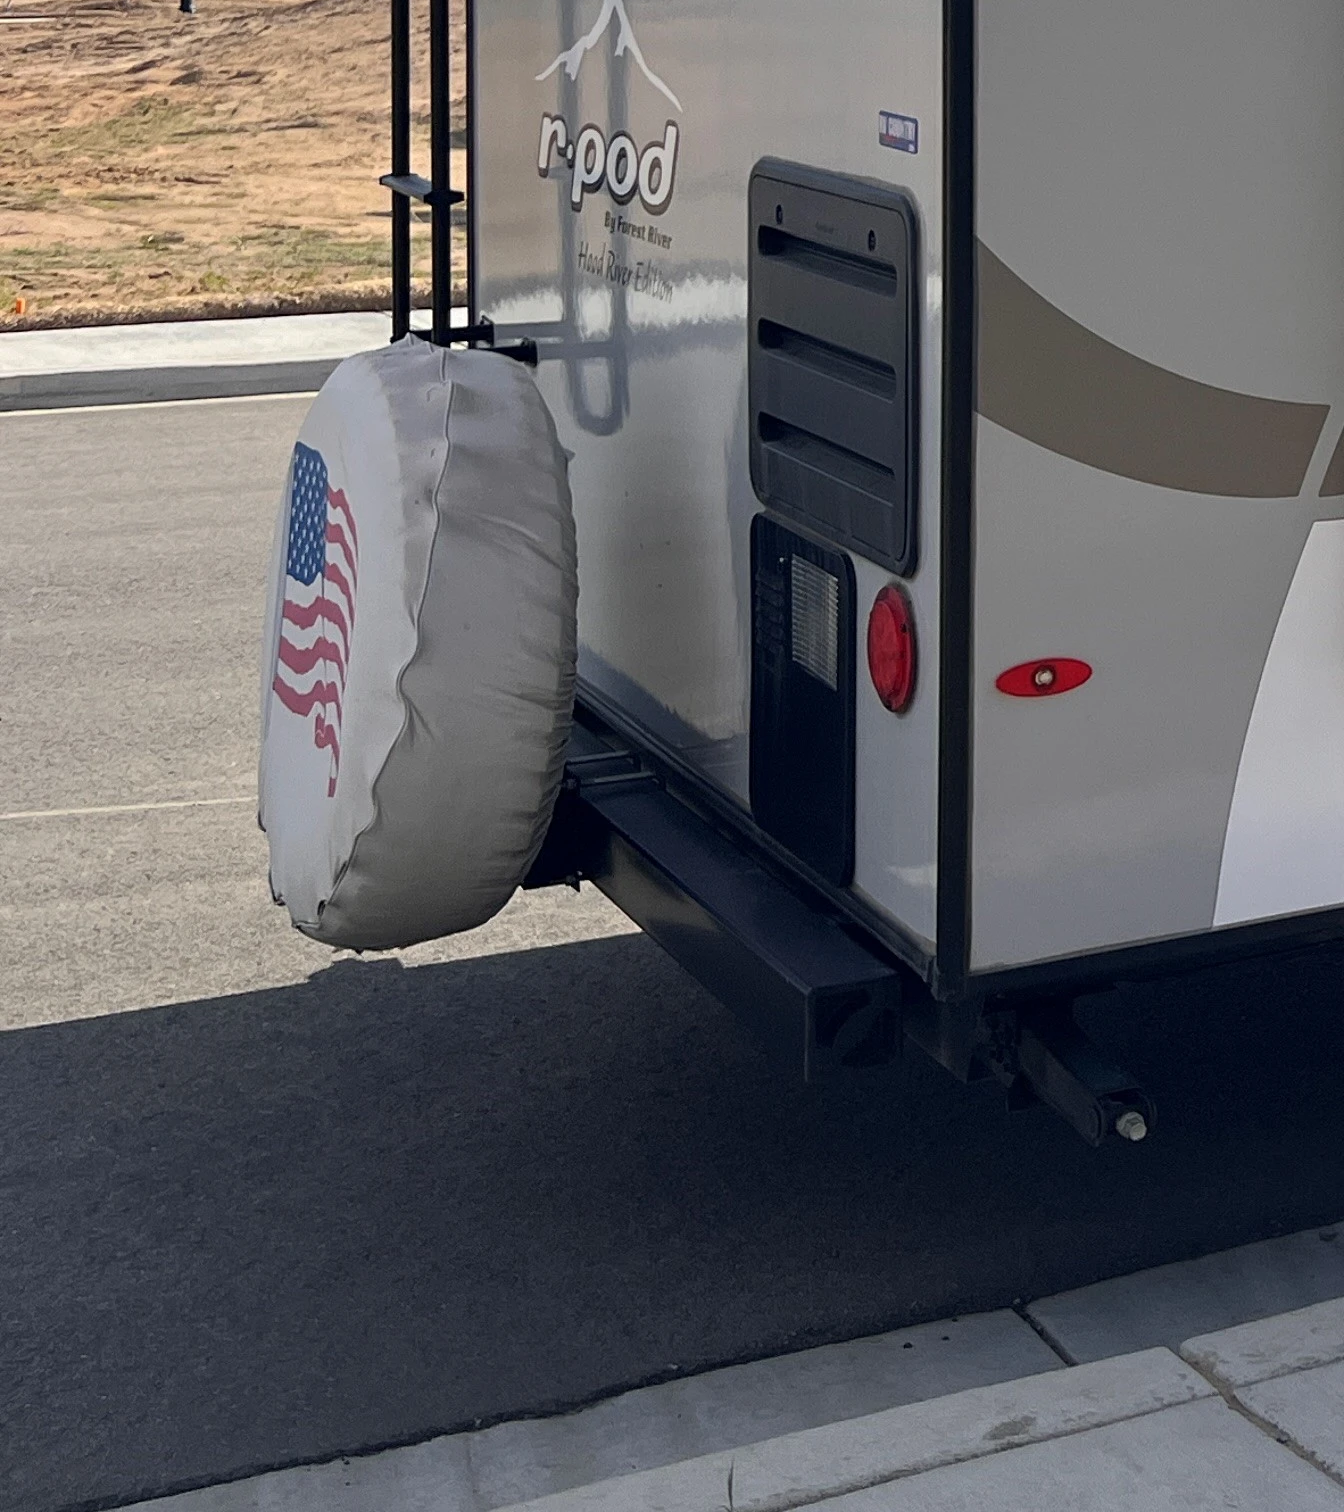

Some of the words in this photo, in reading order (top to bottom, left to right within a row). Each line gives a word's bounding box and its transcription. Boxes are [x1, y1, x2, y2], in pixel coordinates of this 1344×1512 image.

[605, 210, 616, 234] By
[617, 215, 646, 242] Forest
[648, 225, 673, 249] River
[578, 241, 606, 276] Hood
[606, 250, 633, 286] River
[634, 259, 673, 303] Edition
